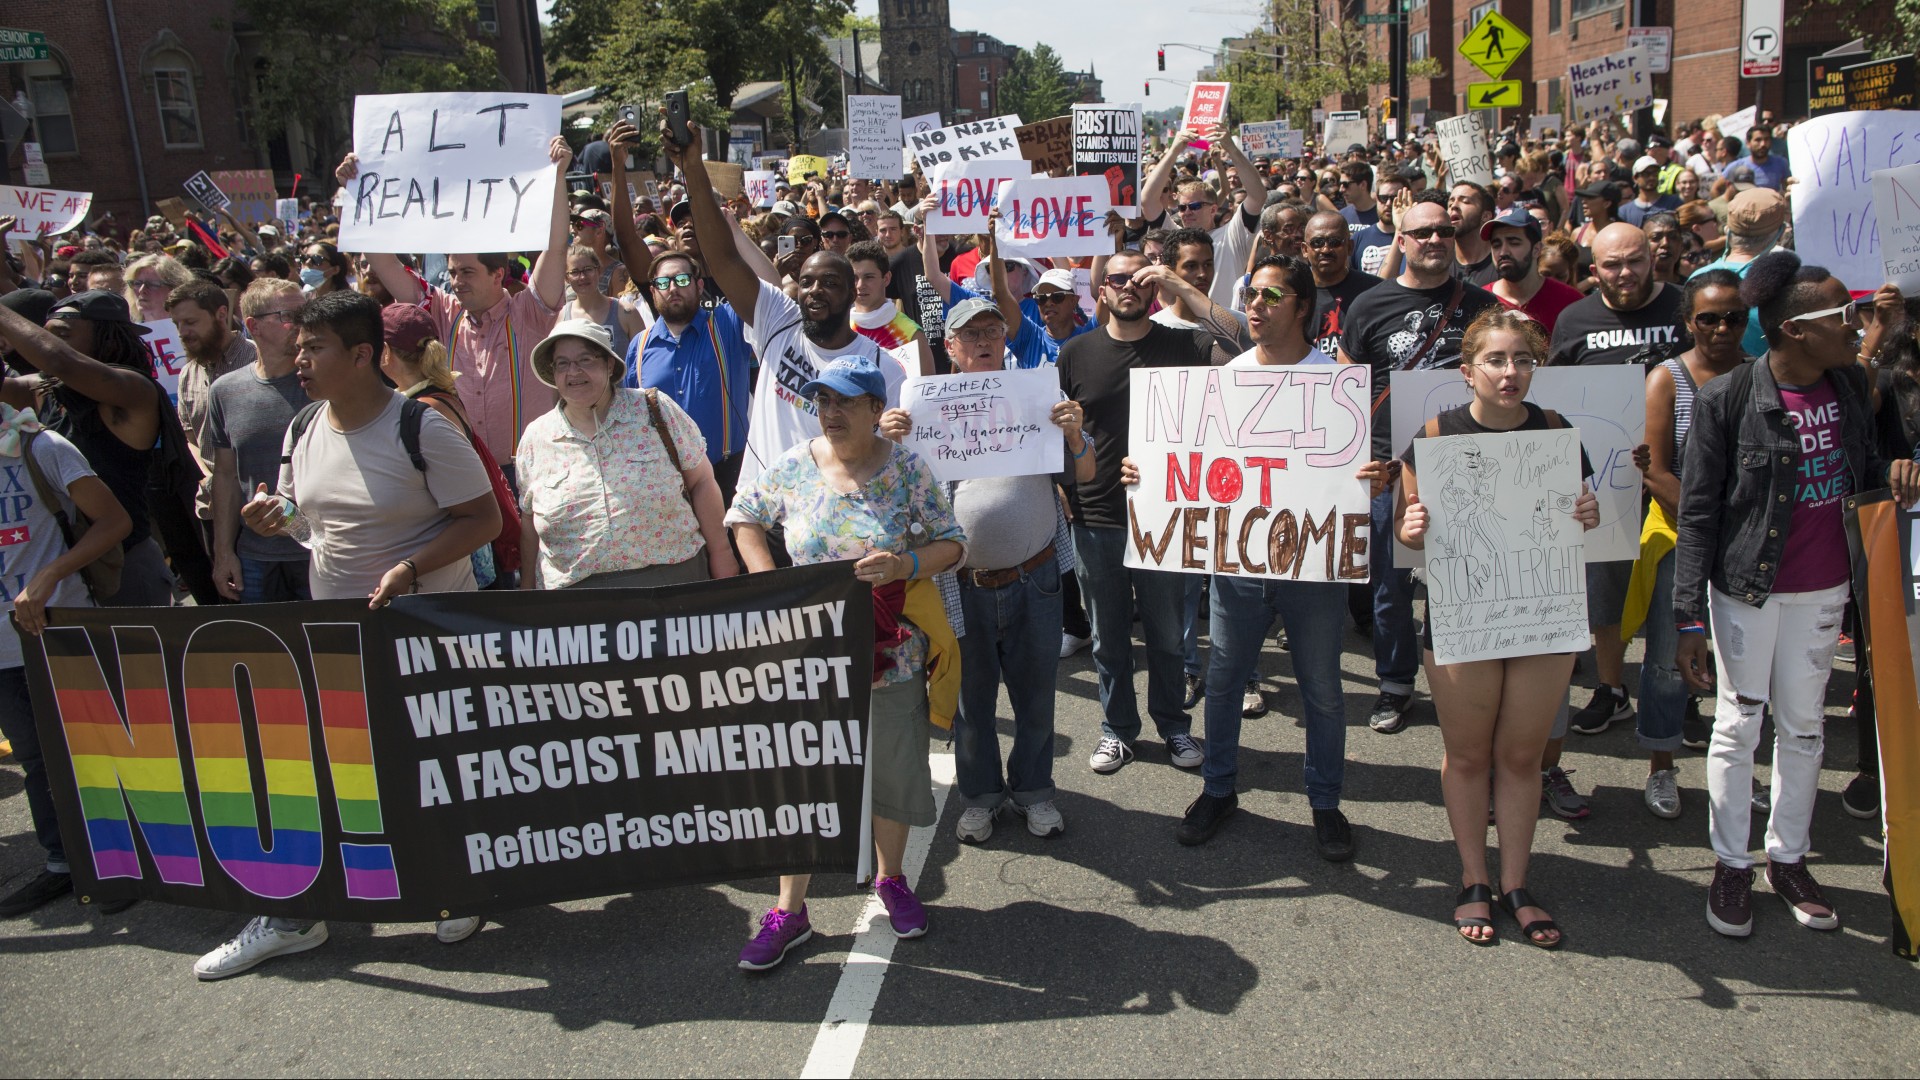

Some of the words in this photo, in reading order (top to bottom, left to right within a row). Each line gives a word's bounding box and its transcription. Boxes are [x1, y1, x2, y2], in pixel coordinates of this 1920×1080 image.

[1570, 56, 1637, 82] Heather
[1852, 62, 1897, 80] QUEERS
[1573, 79, 1621, 98] Heyer
[1849, 74, 1896, 92] AGAINST
[1854, 86, 1889, 102] WHITE
[1197, 90, 1221, 99] NAZIS
[1197, 103, 1214, 112] ARE
[382, 103, 529, 155] ALT
[852, 127, 886, 135] SPEECH
[868, 117, 888, 127] HATE
[1076, 110, 1136, 135] BOSTON
[1436, 116, 1468, 139] WHITE
[911, 130, 947, 151] NO
[1076, 136, 1110, 150] STANDS
[1111, 136, 1137, 150] WITH
[1242, 134, 1262, 143] EVILS
[1252, 142, 1264, 150] NOT
[1449, 140, 1460, 155] IS
[795, 156, 816, 164] FUCK
[1076, 151, 1137, 163] CHARLOTTESVILLE
[217, 170, 267, 179] MAKE
[15, 189, 56, 212] WE
[353, 171, 536, 234] REALITY
[1003, 209, 1046, 231] Not
[1046, 209, 1107, 230] Hate
[1012, 195, 1095, 240] LOVE
[1891, 225, 1902, 235] In
[1586, 325, 1680, 350] EQUALITY.
[913, 377, 1002, 397] TEACHERS
[941, 395, 1003, 422] against
[1146, 365, 1368, 468] NAZIS
[915, 425, 954, 443] Hate,
[1165, 451, 1288, 508] NOT
[1793, 471, 1853, 502] AVES
[1808, 500, 1824, 508] GAP
[1128, 496, 1370, 581] WELCOME
[1428, 554, 1480, 605] STOP
[1454, 603, 1473, 629] We
[1484, 602, 1509, 624] beat
[1532, 598, 1566, 622] before
[395, 636, 437, 676] IN
[437, 631, 507, 670] THE
[511, 623, 610, 668] NAME
[616, 619, 658, 662] OF
[664, 600, 846, 658] HUMANITY
[1493, 633, 1520, 650] beat
[1541, 627, 1573, 647] again
[404, 687, 479, 739] WE
[482, 679, 634, 728] REFUSE
[633, 673, 692, 715] TO
[699, 656, 853, 710] ACCEPT
[39, 619, 402, 900] NO!
[418, 758, 453, 809] A
[456, 733, 642, 802] FASCIST
[653, 719, 864, 777] AMERICA!
[464, 801, 842, 875] RefuseFascism.org
